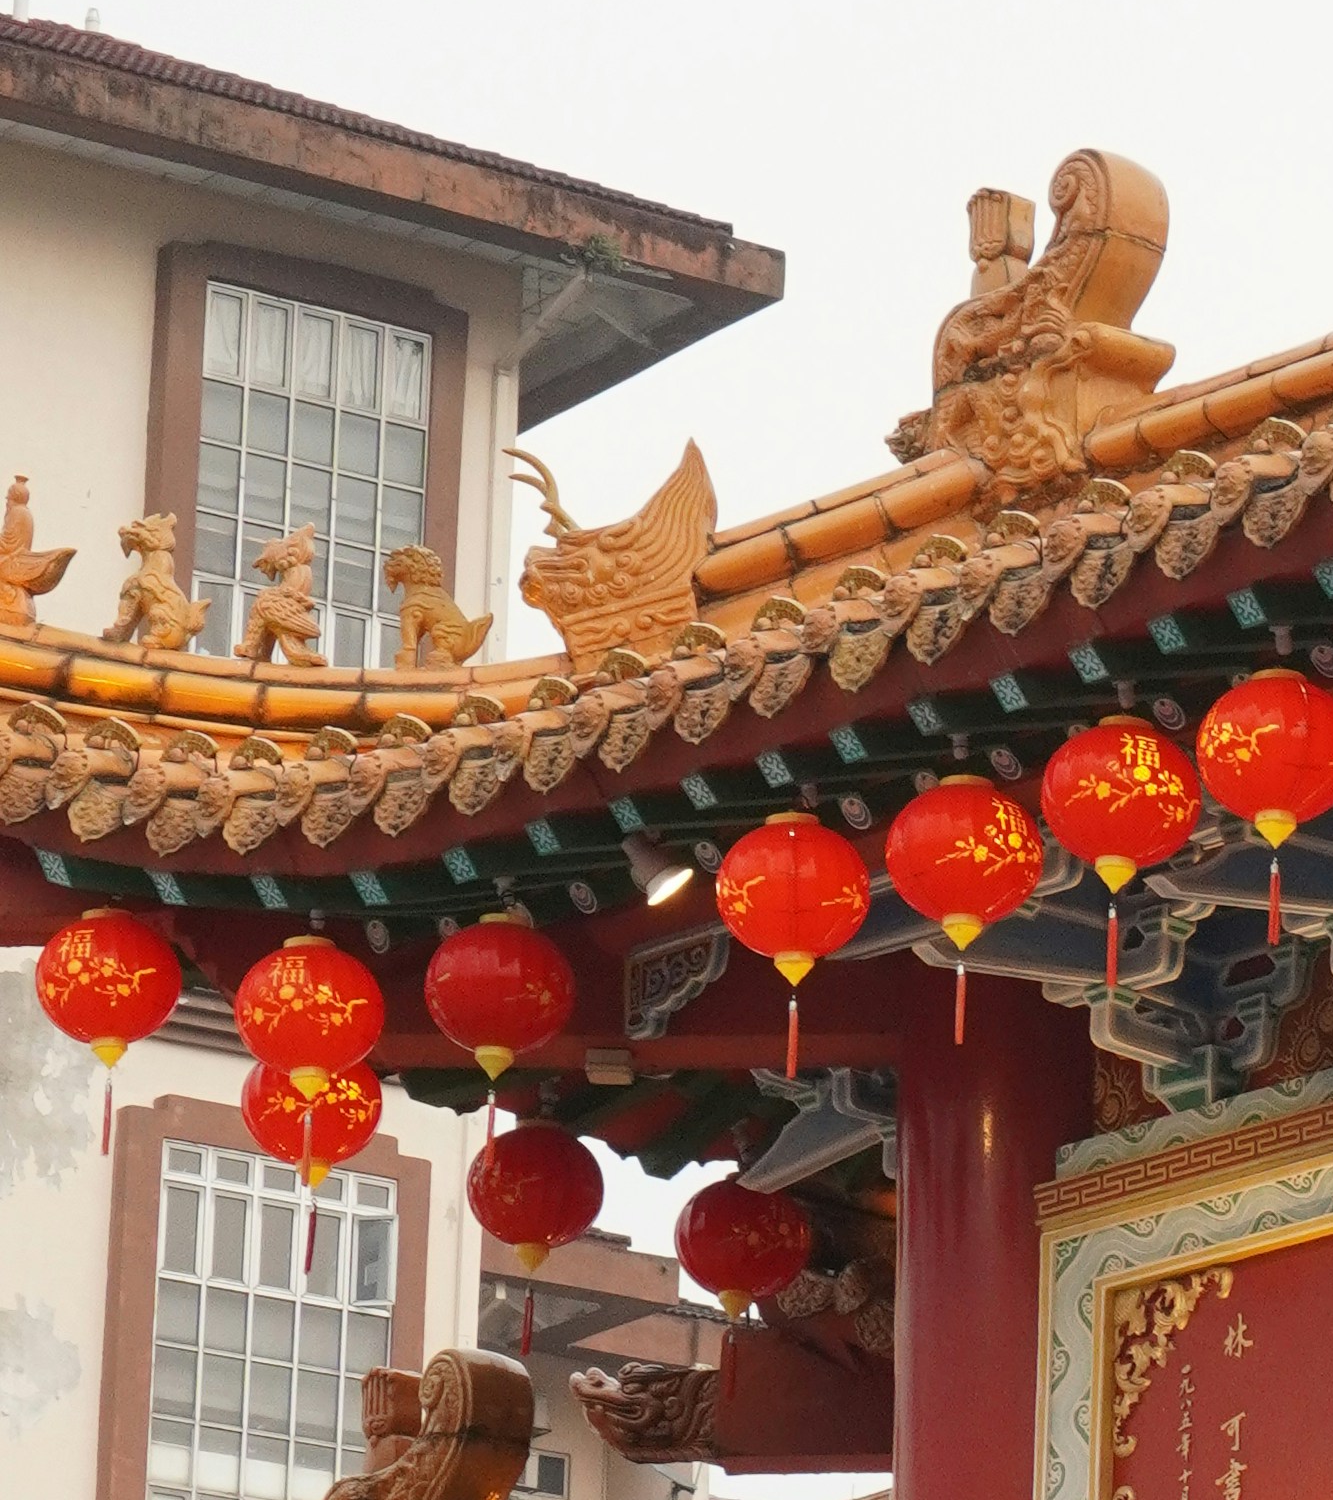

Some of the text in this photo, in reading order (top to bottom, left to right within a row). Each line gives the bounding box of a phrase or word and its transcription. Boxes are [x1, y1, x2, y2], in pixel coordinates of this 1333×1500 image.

[1119, 733, 1160, 769] 福
[992, 797, 1028, 837] 福
[60, 930, 94, 962] 福
[269, 956, 307, 987] 福
